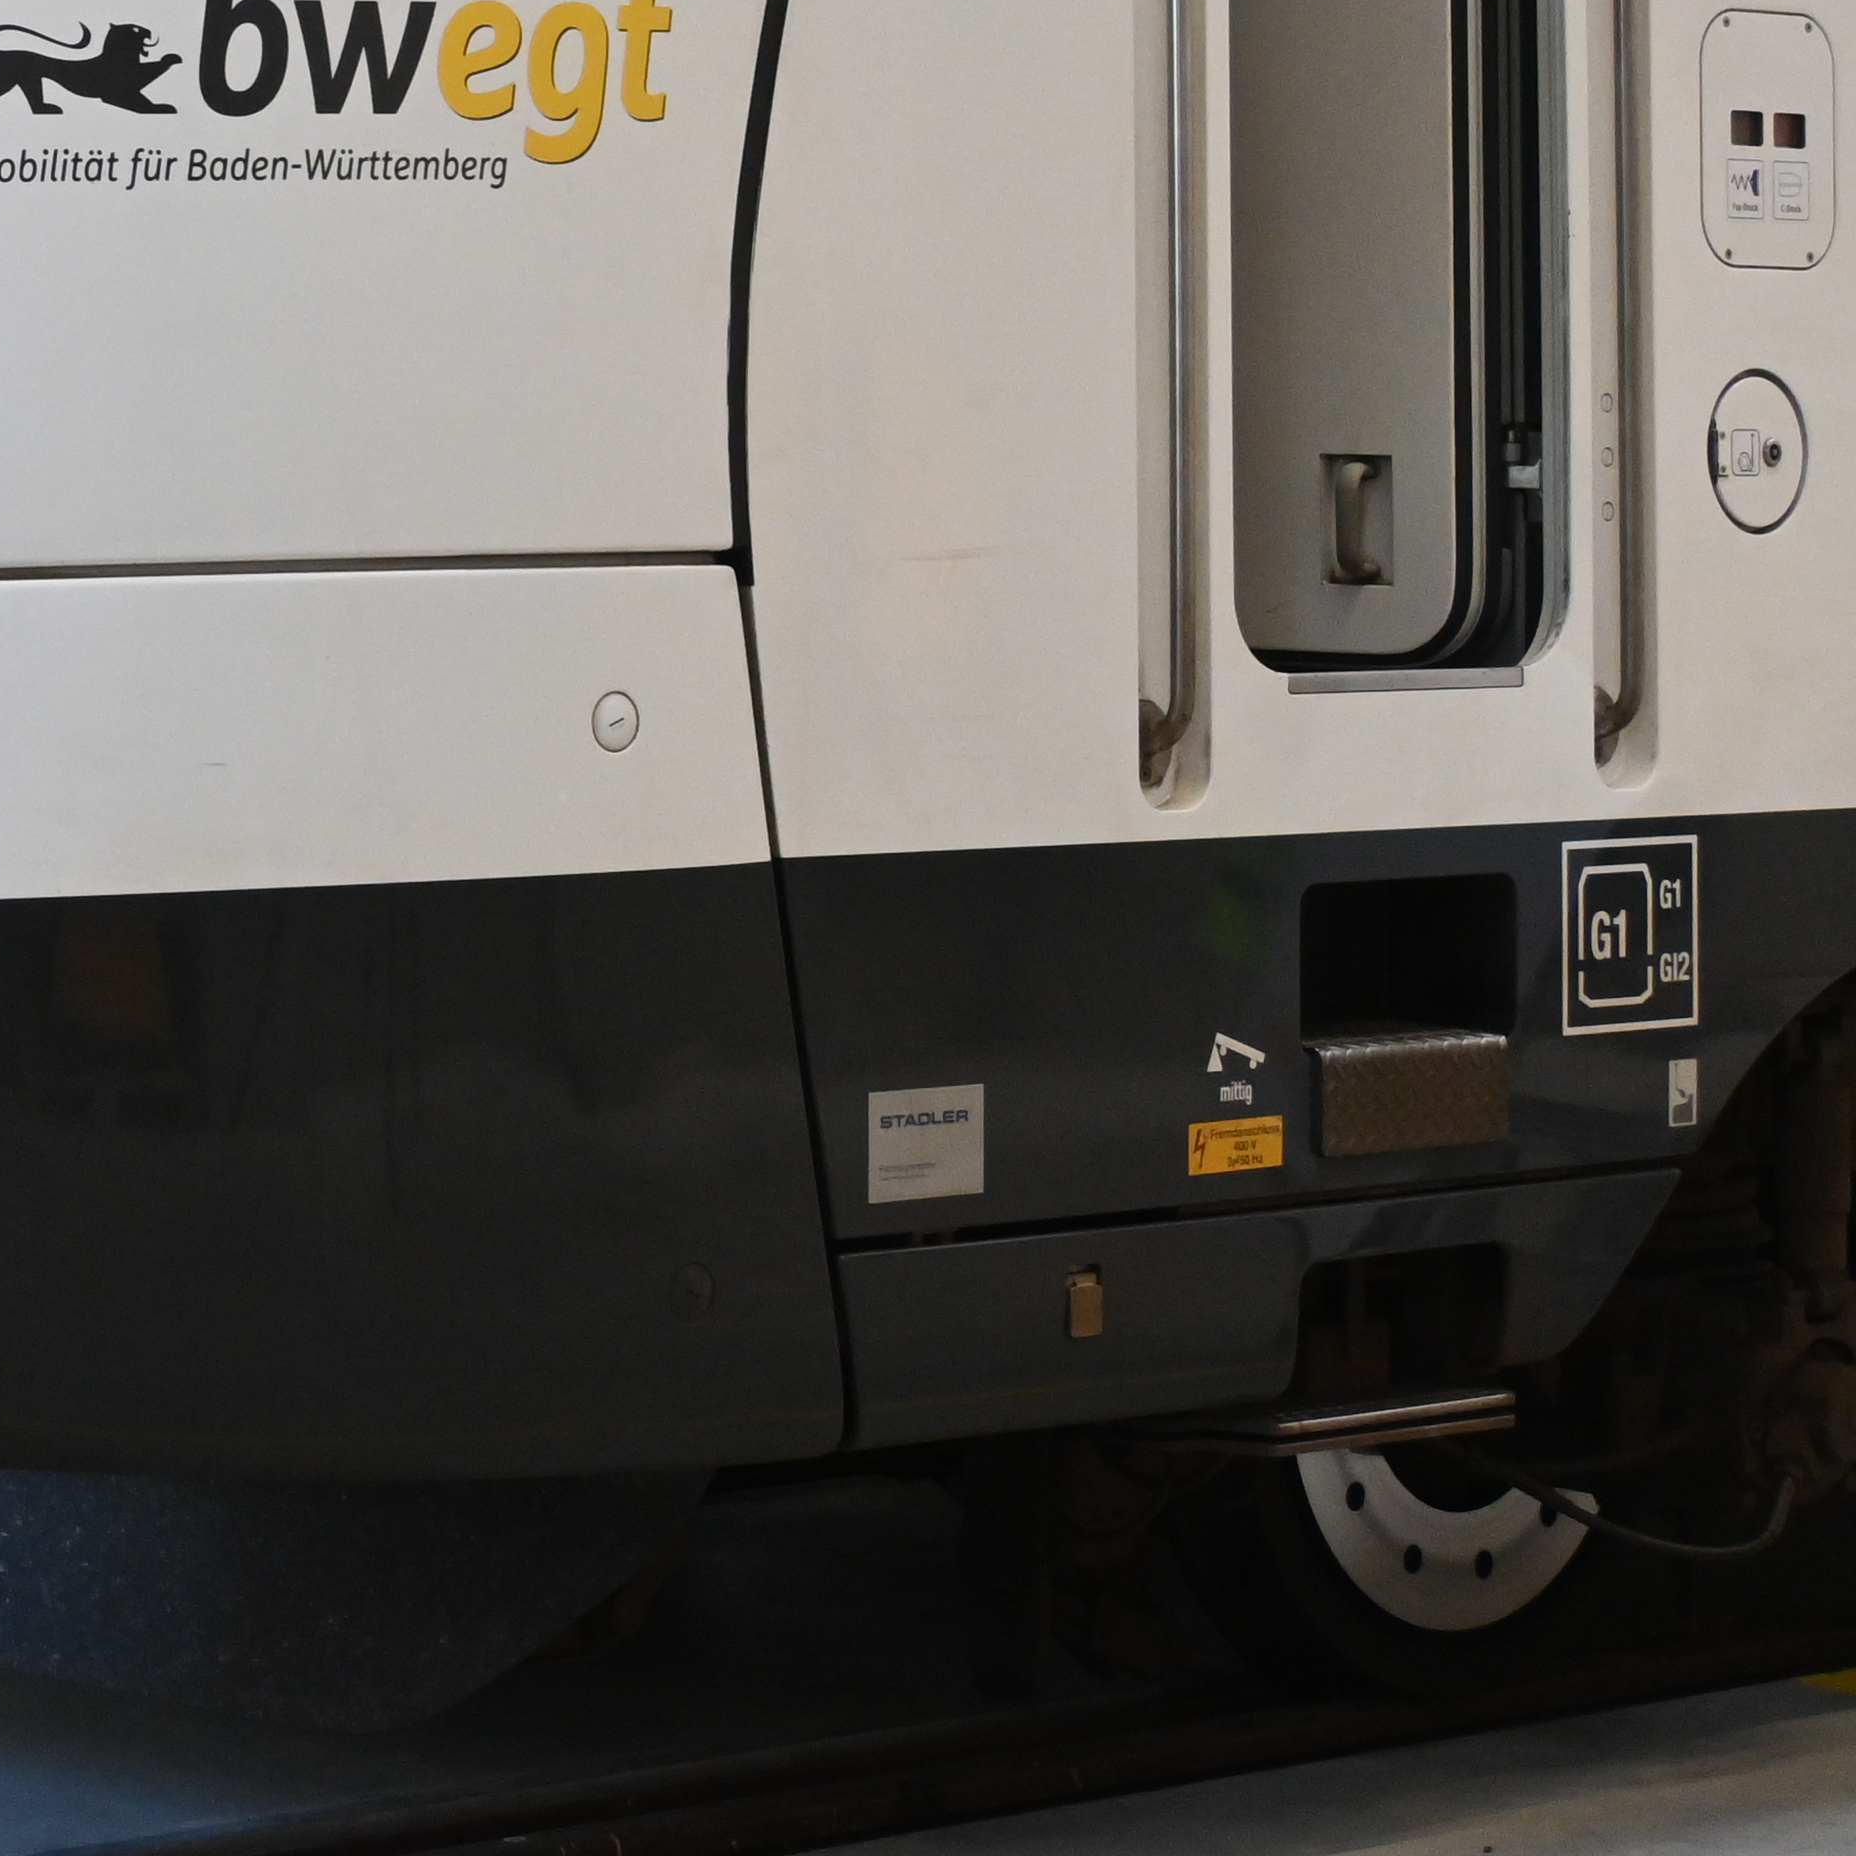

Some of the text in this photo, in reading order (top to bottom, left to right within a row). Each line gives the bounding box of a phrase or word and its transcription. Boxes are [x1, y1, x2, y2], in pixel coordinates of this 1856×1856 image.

[125, 147, 178, 191] für
[187, 147, 508, 190] Baden-Württemberg
[1659, 878, 1682, 909] G1
[1590, 909, 1627, 961] G1
[1219, 1079, 1253, 1106] mittig
[879, 1109, 969, 1130] STADLER
[1250, 1138, 1258, 1150] V
